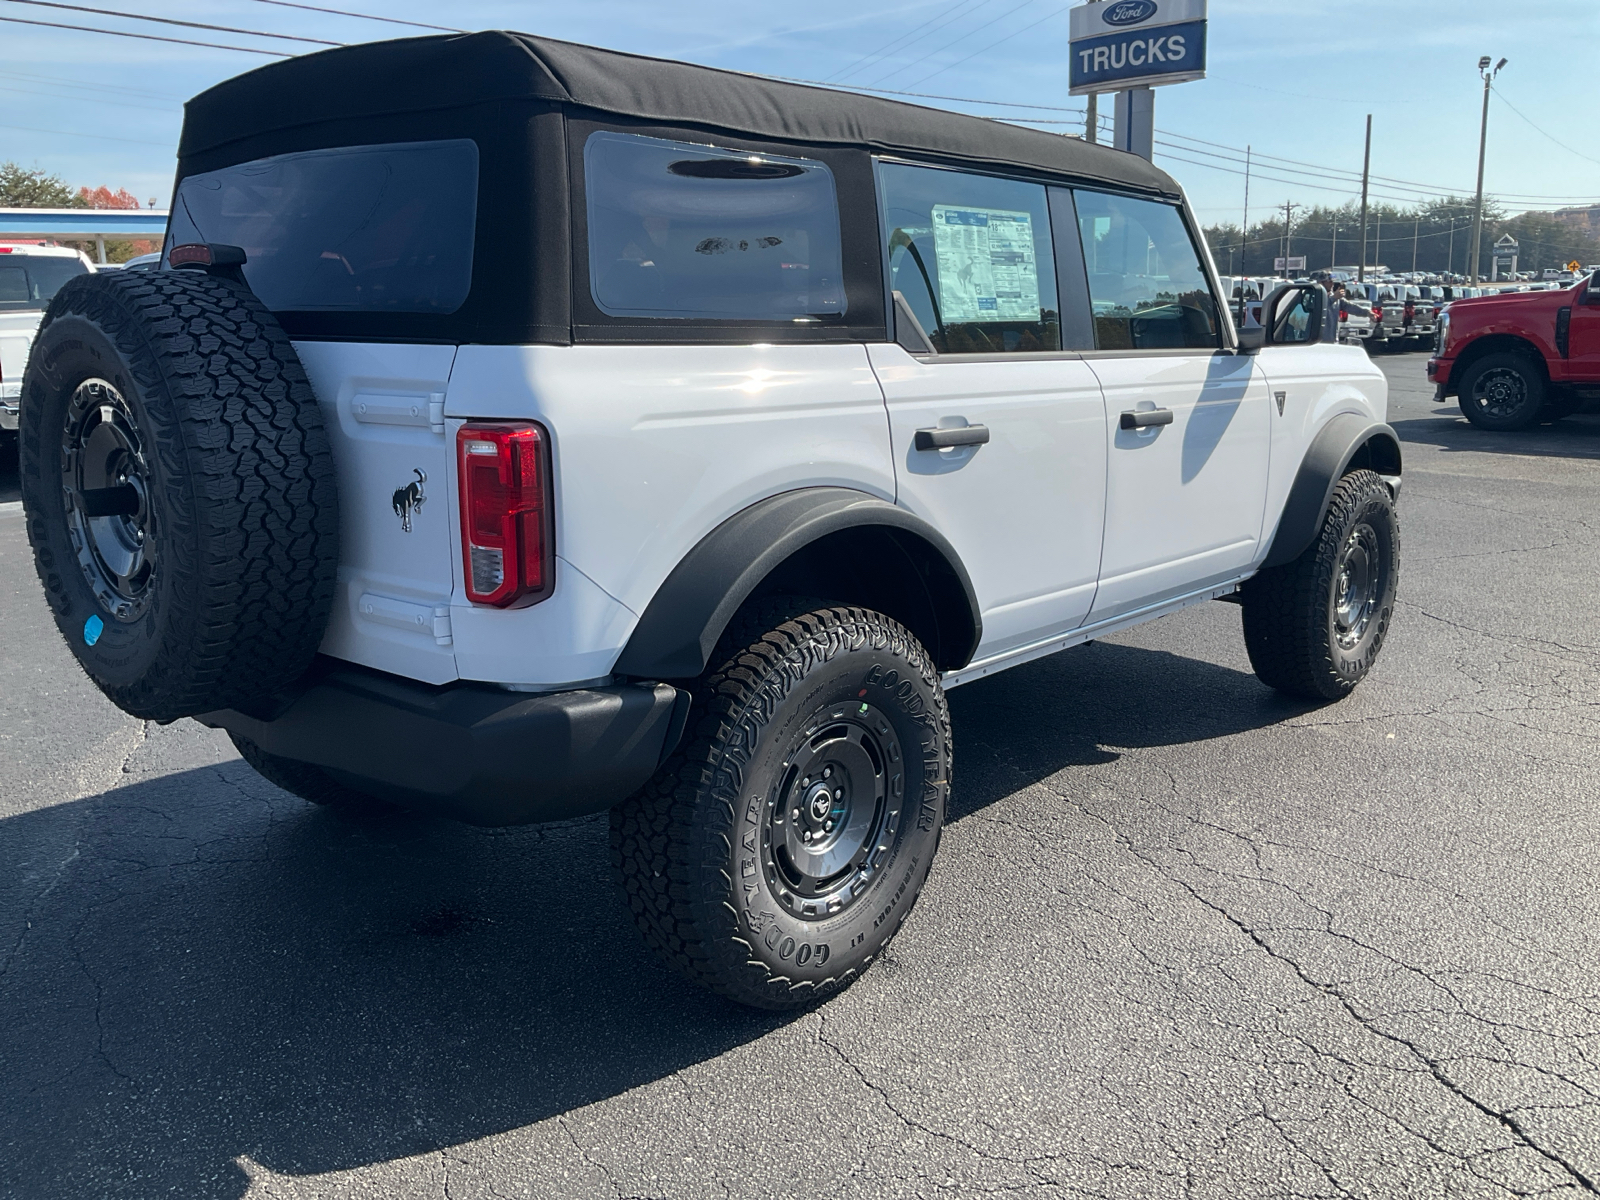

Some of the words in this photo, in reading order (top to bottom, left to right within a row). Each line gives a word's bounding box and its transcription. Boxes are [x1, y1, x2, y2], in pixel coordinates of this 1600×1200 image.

[1113, 3, 1143, 21] Ford
[1079, 35, 1186, 74] TRUCKS
[864, 662, 941, 833] GOODYEAR
[740, 794, 831, 968] GOODYEAR
[872, 855, 920, 932] TERRITORY
